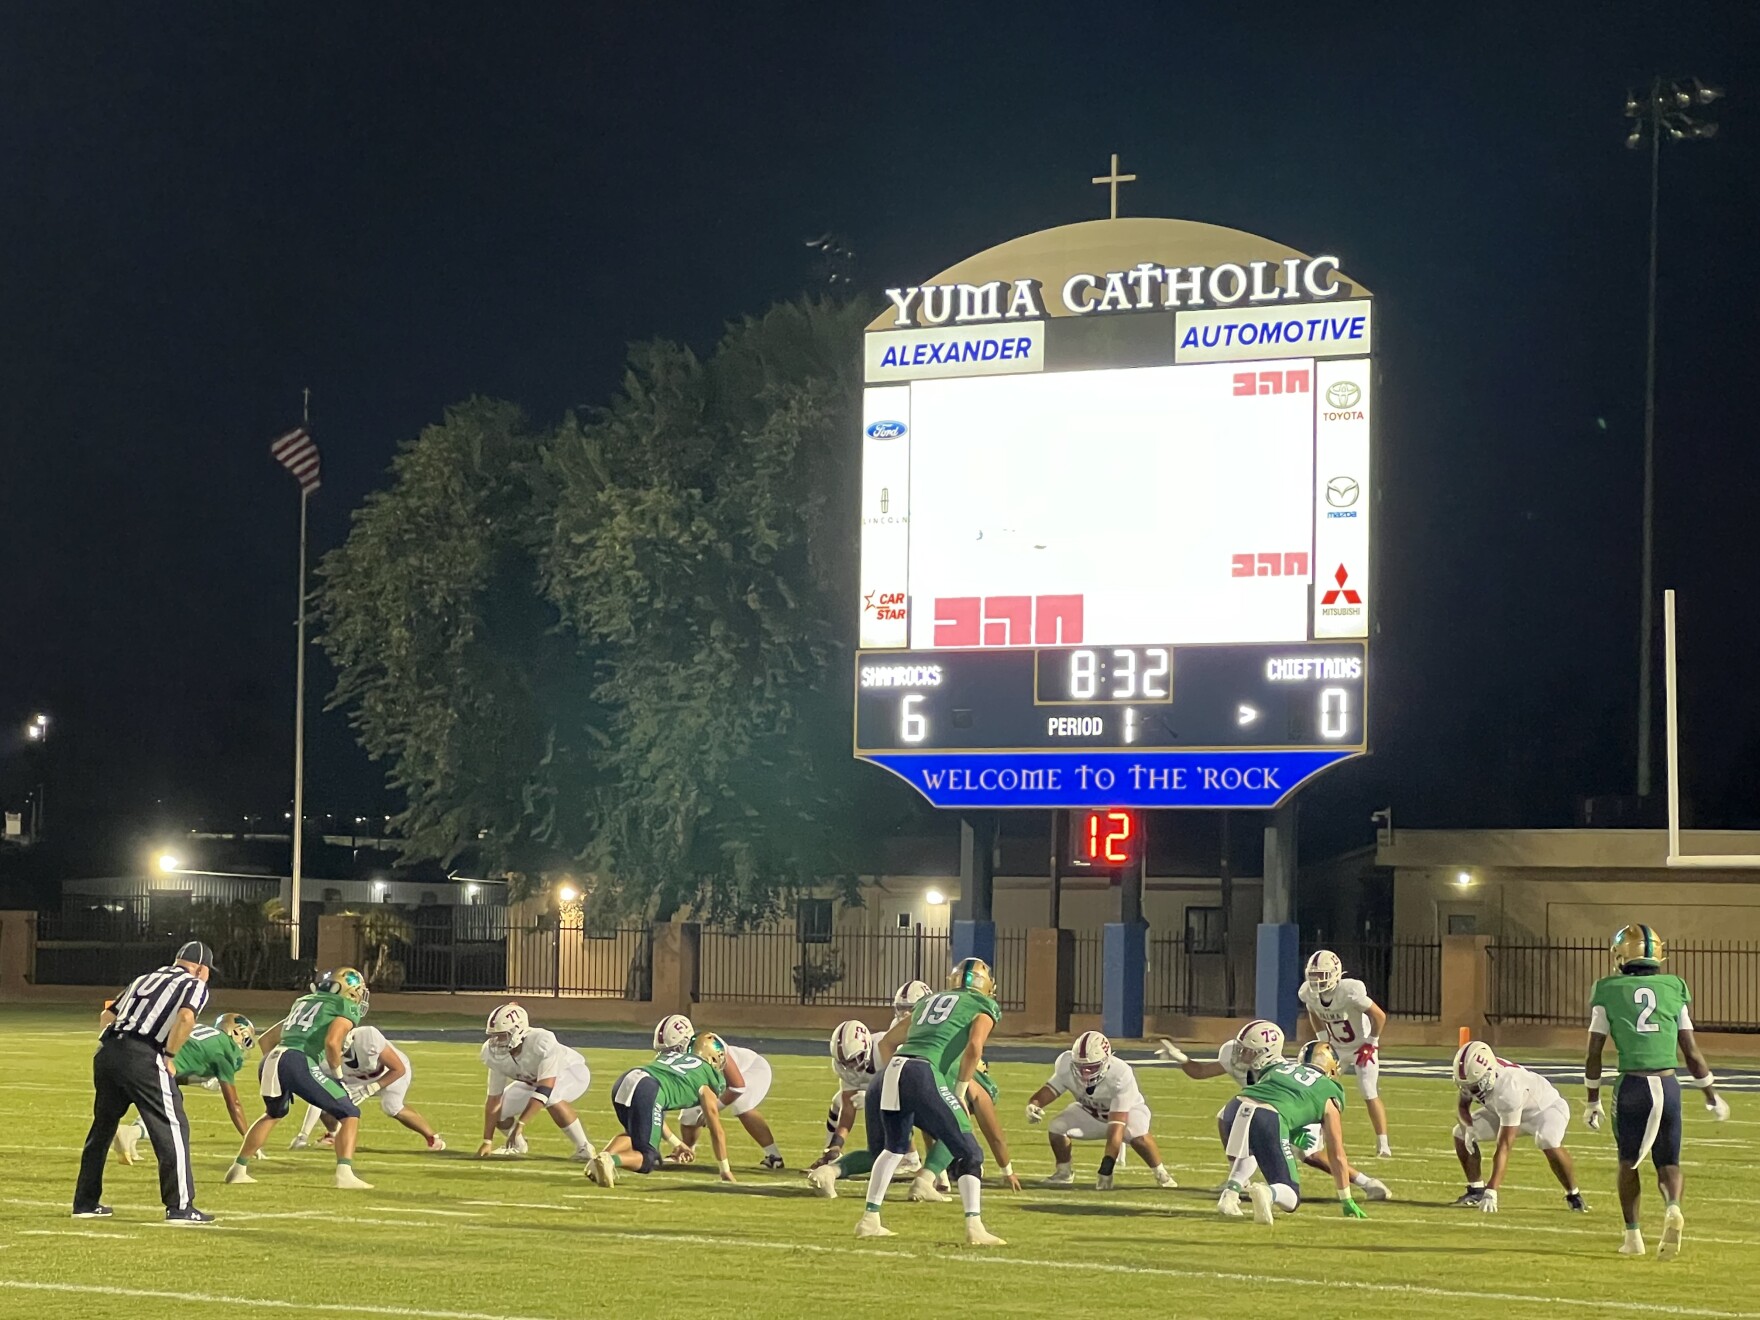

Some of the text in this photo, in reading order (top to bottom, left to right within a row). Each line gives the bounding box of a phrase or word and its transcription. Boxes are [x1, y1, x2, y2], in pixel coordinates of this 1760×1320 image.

[885, 256, 1339, 325] YUMA CATHOLIC
[1180, 316, 1366, 349] AUTOMOTIVE
[880, 337, 1032, 367] ALEXANDER
[1323, 411, 1364, 421] TOYOTA
[863, 516, 908, 525] LINCOLN
[876, 608, 906, 620] STAR
[879, 593, 905, 605] CAR
[1322, 607, 1361, 616] MITSUBISHI
[861, 664, 943, 688] SHAMROCKS
[1071, 648, 1168, 698] 8:32
[1267, 657, 1361, 680] CHIEFTAINS
[902, 694, 926, 742] 6
[1048, 707, 1135, 744] PERIOD 1
[1321, 687, 1347, 738] 0
[922, 768, 1062, 790] WELCOME
[1074, 764, 1115, 790] TO
[1128, 764, 1187, 790] THE
[1090, 812, 1129, 861] 12
[283, 1001, 323, 1031] 44
[505, 1009, 521, 1023] 77
[916, 993, 960, 1025] 19
[1634, 987, 1660, 1032] 2
